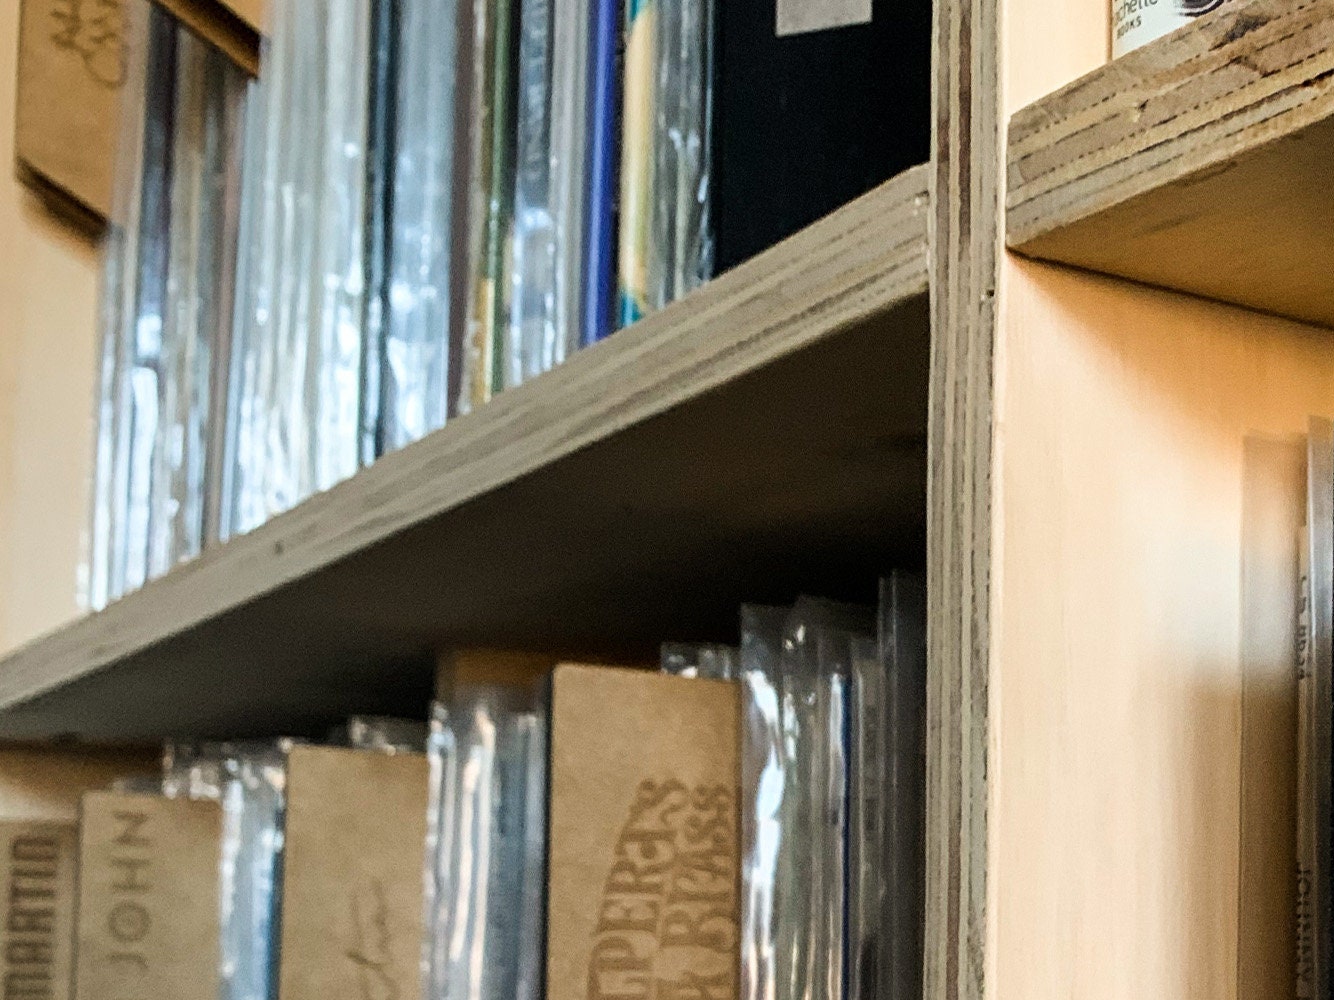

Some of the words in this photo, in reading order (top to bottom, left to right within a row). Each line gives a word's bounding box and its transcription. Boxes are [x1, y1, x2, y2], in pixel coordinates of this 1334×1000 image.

[107, 810, 153, 970] JOHN
[660, 784, 734, 952] BRASS
[1296, 864, 1312, 984] JOHNNY
